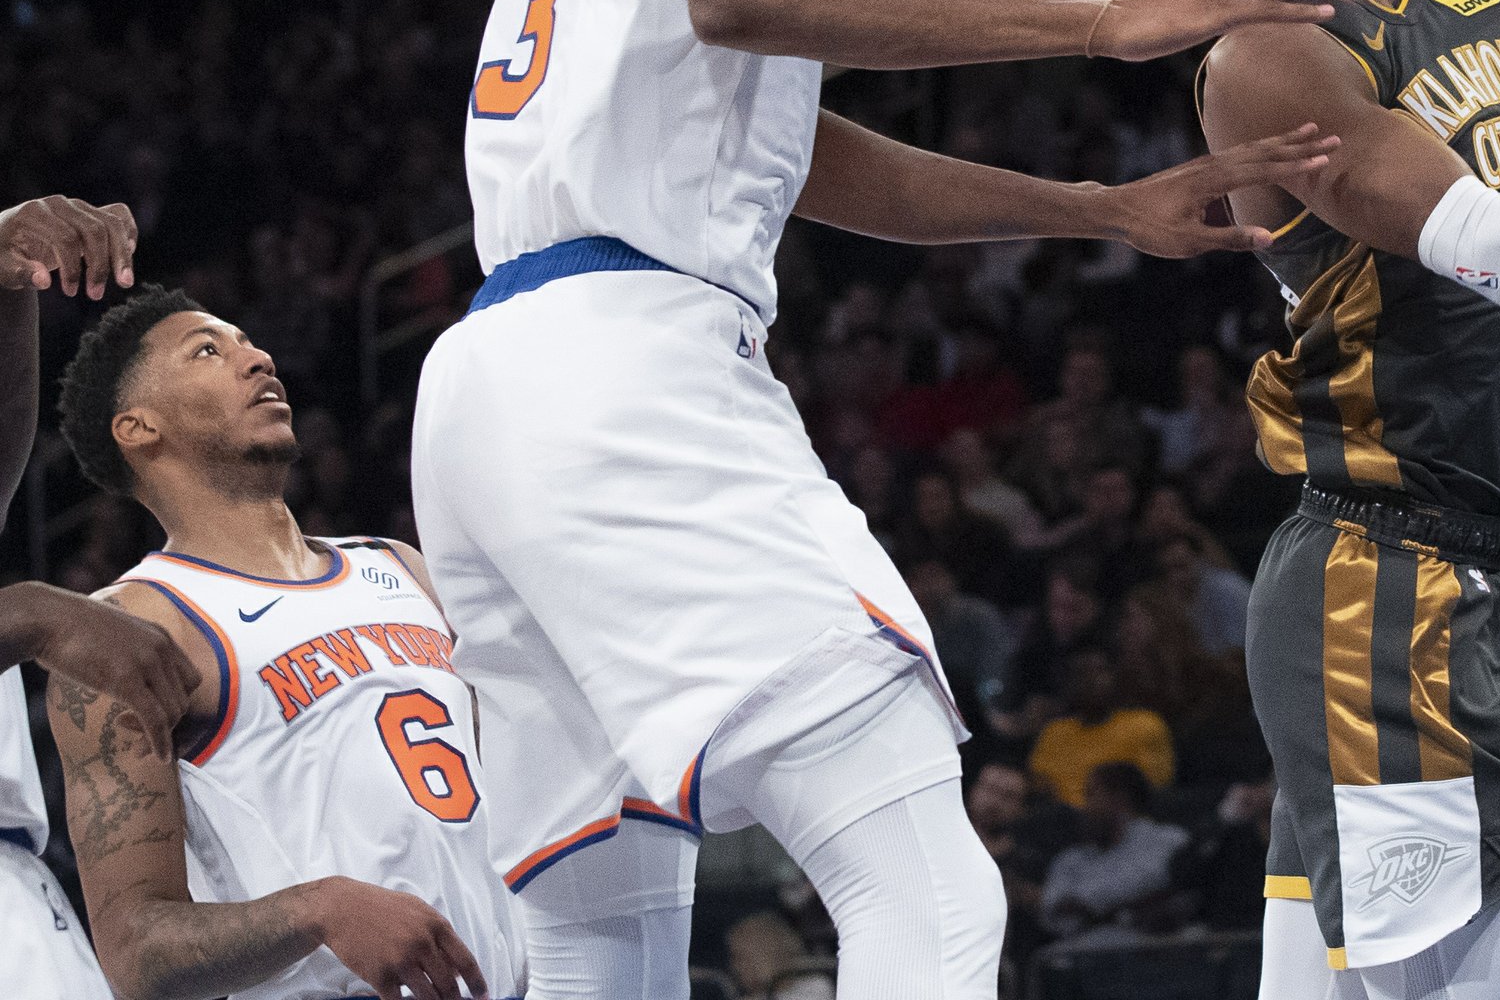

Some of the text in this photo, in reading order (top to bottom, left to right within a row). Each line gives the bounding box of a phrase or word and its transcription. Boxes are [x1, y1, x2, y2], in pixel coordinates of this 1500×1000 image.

[257, 622, 457, 727] NEW YORK
[374, 687, 481, 824] 6
[1370, 846, 1431, 892] OKC
